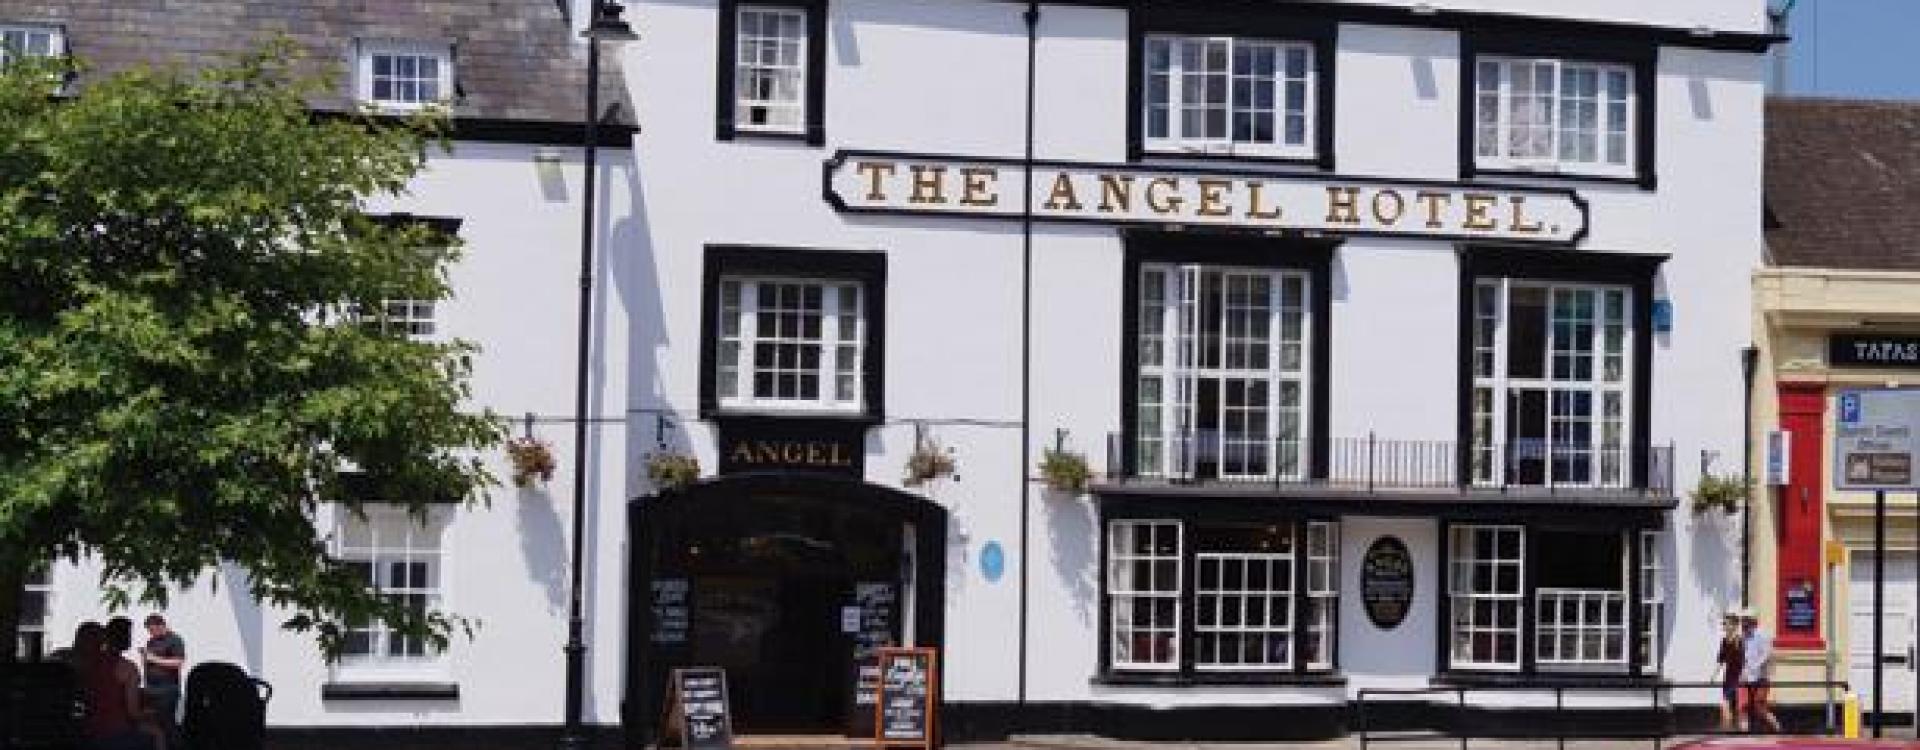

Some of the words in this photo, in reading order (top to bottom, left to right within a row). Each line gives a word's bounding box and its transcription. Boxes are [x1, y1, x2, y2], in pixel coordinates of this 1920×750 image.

[856, 161, 998, 206] THE
[1042, 171, 1283, 220] ANGEL
[1854, 343, 1918, 360] TAPAS
[731, 441, 852, 465] ANGEL
